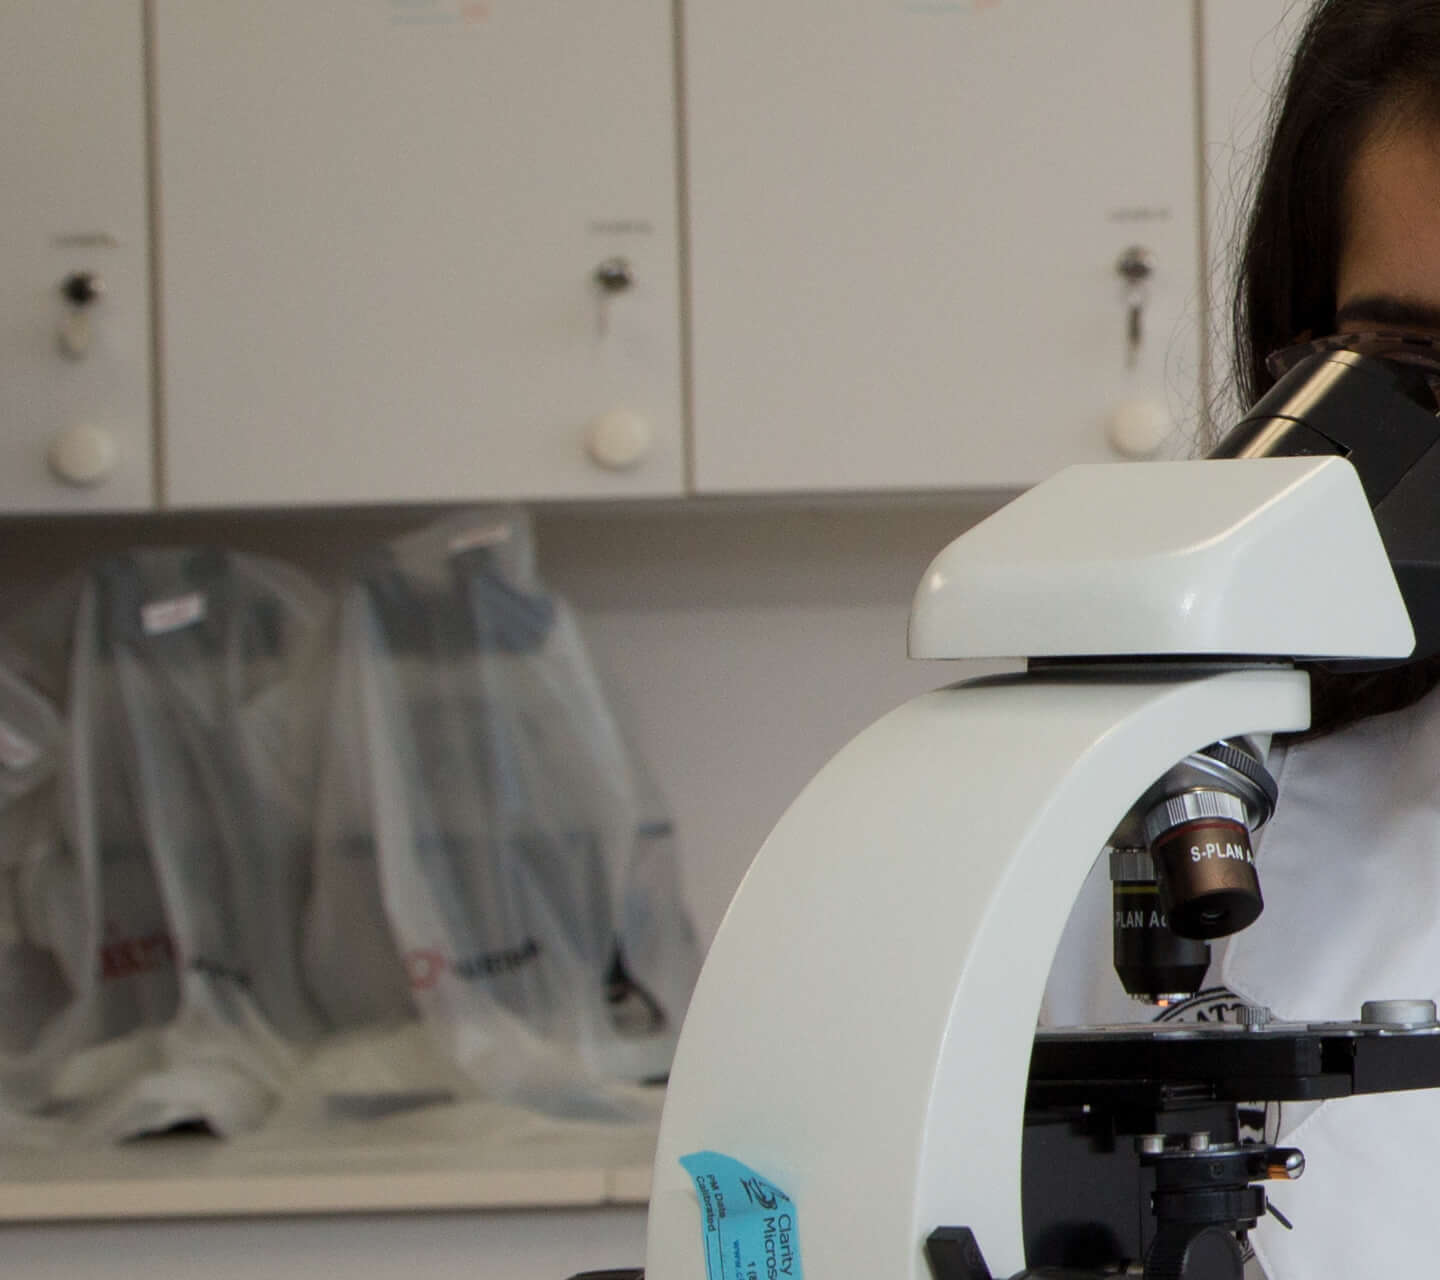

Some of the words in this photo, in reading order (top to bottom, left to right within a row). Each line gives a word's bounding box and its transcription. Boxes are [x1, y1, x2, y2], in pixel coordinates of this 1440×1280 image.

[1190, 842, 1243, 862] S-PLAN
[696, 1175, 716, 1232] Calibrated
[715, 1193, 726, 1218] Date
[778, 1213, 793, 1277] Clarity
